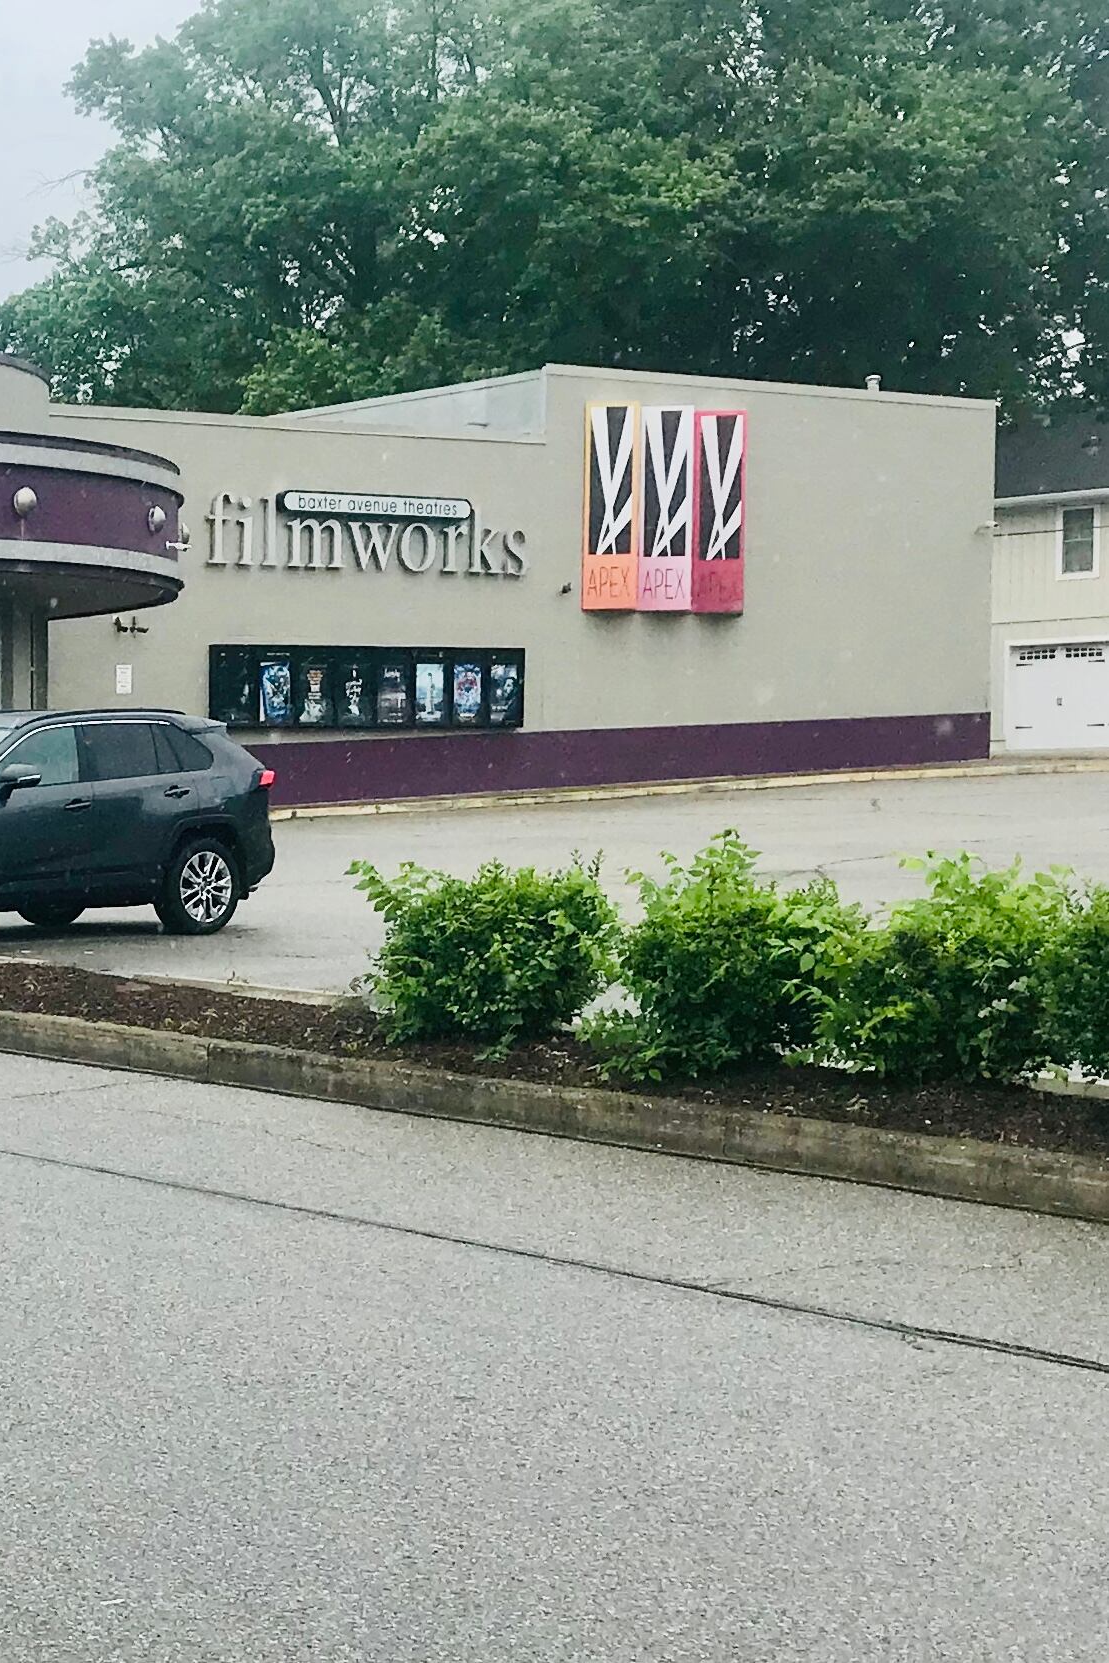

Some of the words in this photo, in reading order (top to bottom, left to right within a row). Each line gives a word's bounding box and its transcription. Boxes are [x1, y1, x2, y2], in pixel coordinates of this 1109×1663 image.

[298, 494, 342, 511] baxter
[347, 498, 398, 514] avenue
[403, 501, 458, 516] theatres
[204, 489, 530, 577] filmworks
[587, 566, 631, 599] APEX
[642, 568, 686, 600] APEX
